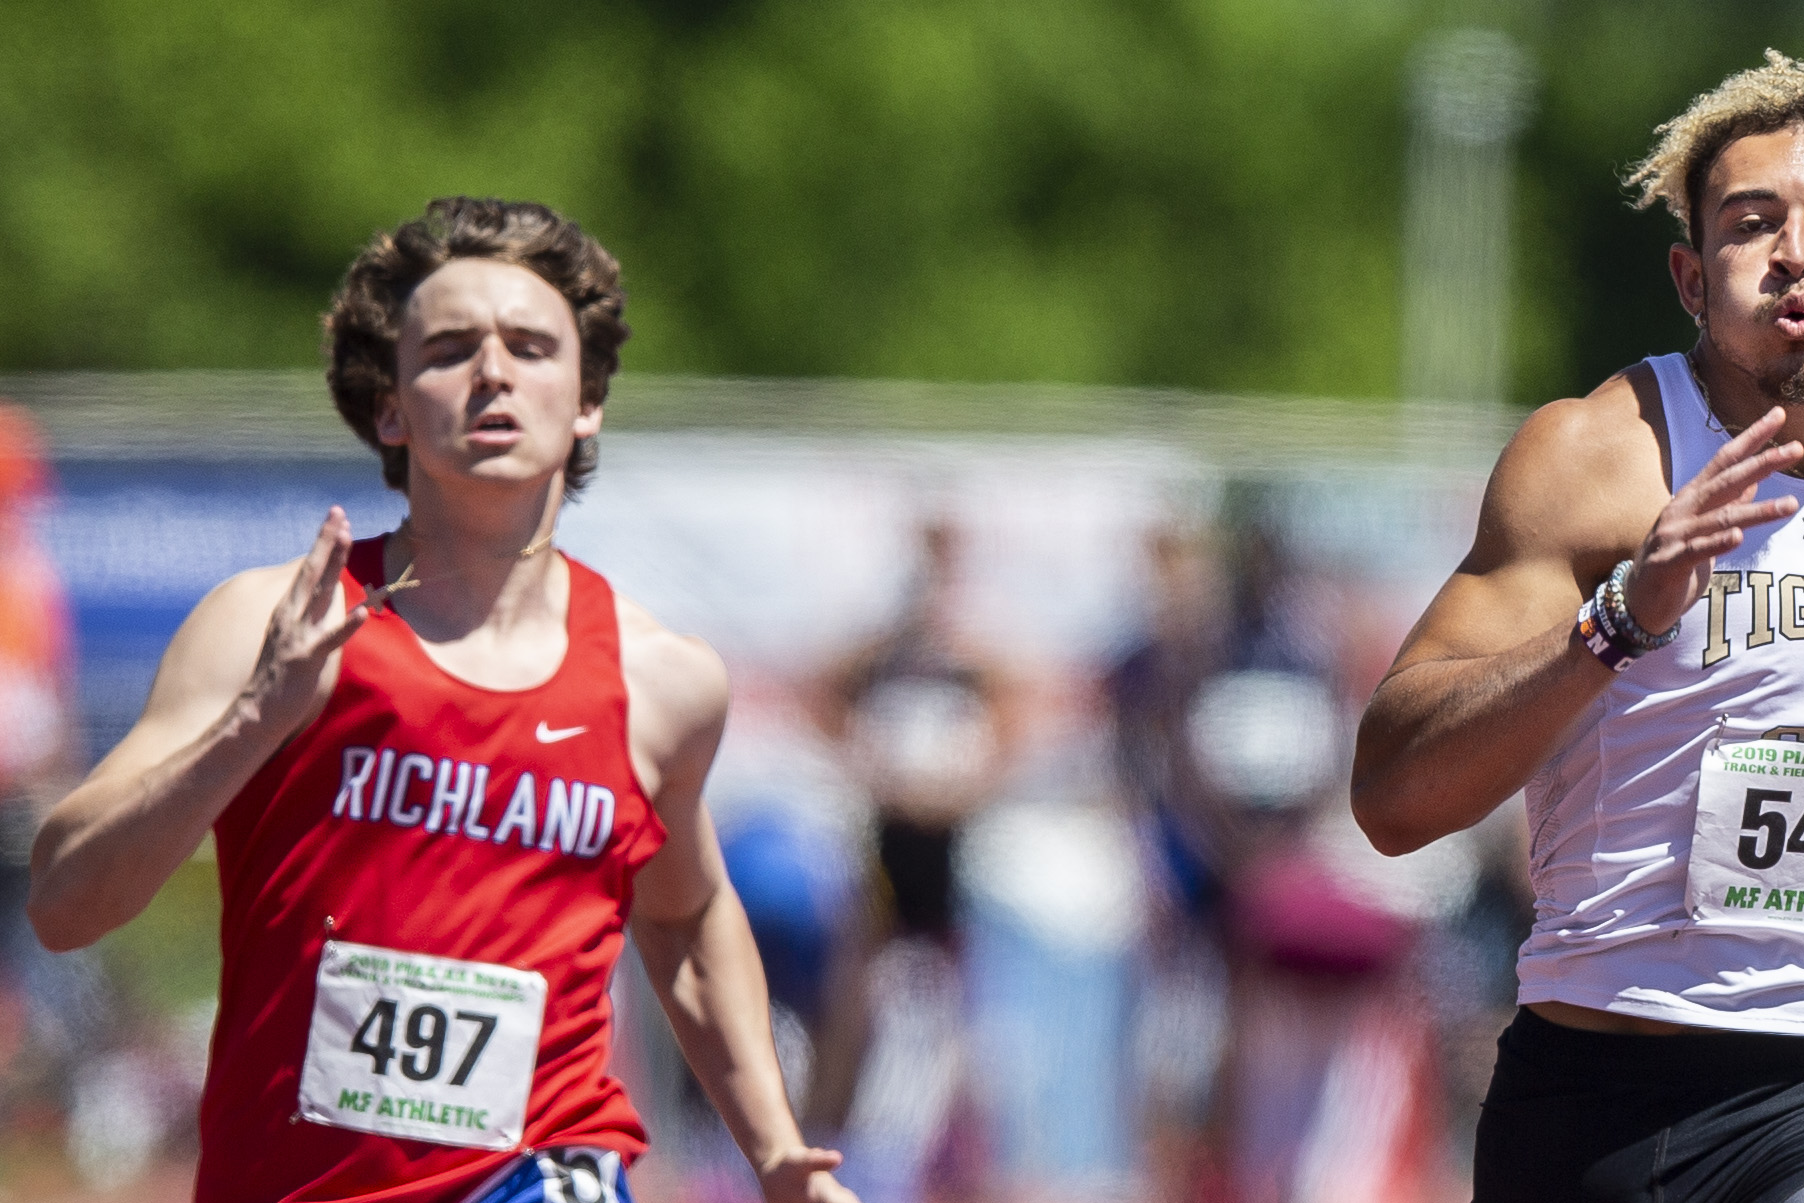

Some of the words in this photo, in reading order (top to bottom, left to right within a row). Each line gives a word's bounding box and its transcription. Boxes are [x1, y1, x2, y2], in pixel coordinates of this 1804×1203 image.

[1723, 761, 1766, 775] TRACK
[1769, 766, 1779, 776] &
[1732, 746, 1777, 763] 2019
[333, 745, 616, 858] RICHLAND
[1724, 886, 1762, 909] MF
[350, 998, 500, 1087] 497
[338, 1087, 373, 1113] MF
[376, 1095, 489, 1131] ATHLETIC
